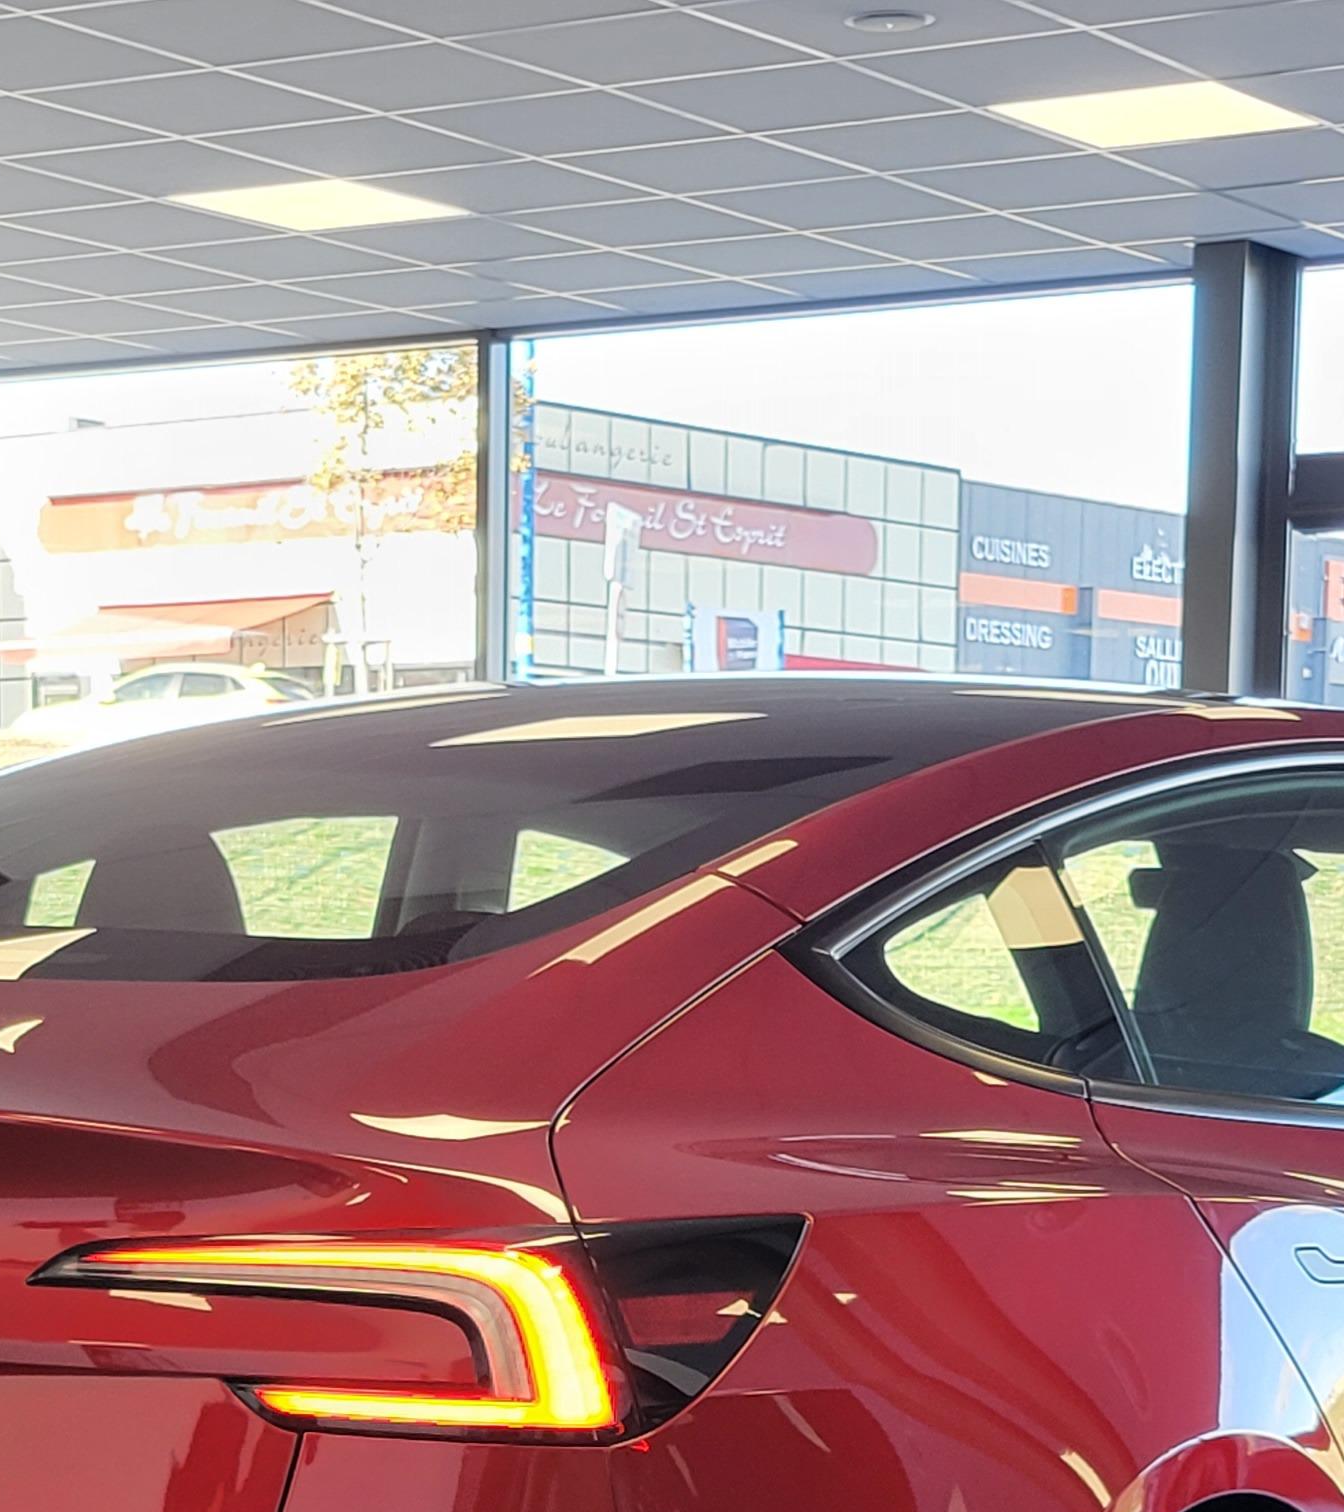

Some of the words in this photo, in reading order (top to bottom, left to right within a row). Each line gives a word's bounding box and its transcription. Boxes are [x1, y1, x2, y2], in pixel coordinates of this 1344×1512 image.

[570, 483, 666, 531] Foil
[972, 535, 1052, 568] CUISINES
[965, 617, 1054, 650] DRESSING
